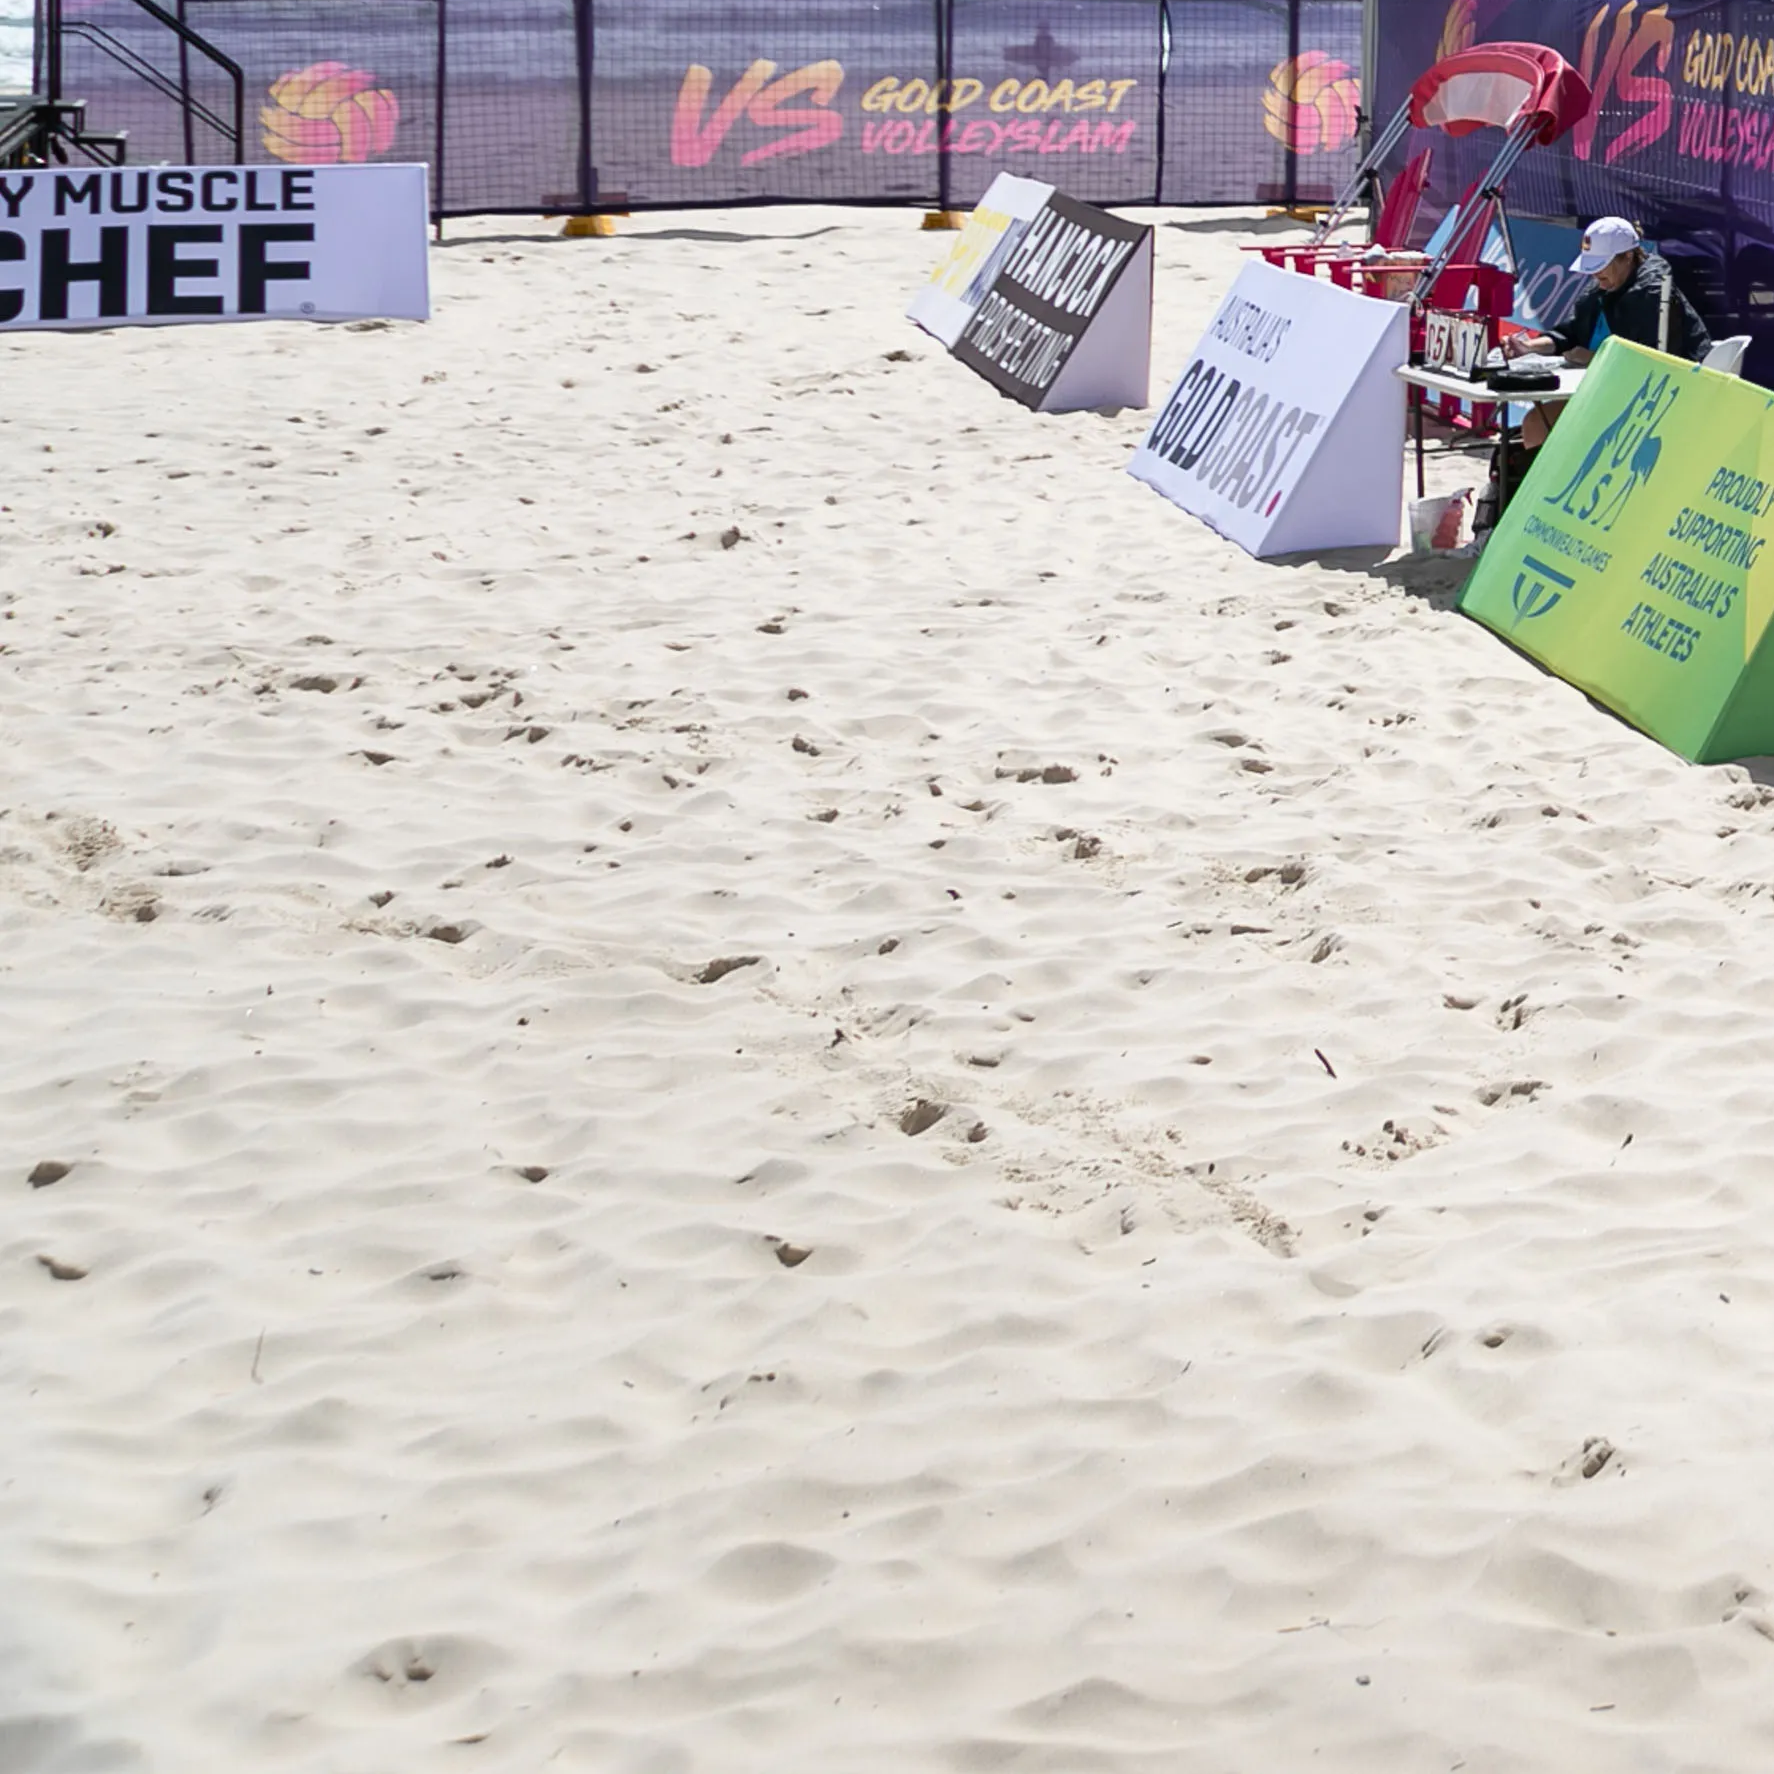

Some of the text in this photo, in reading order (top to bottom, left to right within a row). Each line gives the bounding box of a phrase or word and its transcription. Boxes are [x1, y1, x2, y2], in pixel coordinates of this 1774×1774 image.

[1683, 28, 1735, 92] GOLD
[671, 59, 845, 167] VS
[861, 76, 1138, 113] GOLD COAST
[861, 119, 1137, 155] VOLLEYSLAM
[54, 170, 315, 216] MUSCLE
[0, 223, 315, 322] HEF
[1004, 205, 1135, 318] HANCOCK
[1667, 506, 1766, 570] SUPPORTING
[1640, 552, 1739, 618] AUSTRALIA'S
[1620, 601, 1702, 663] ATHLETES
